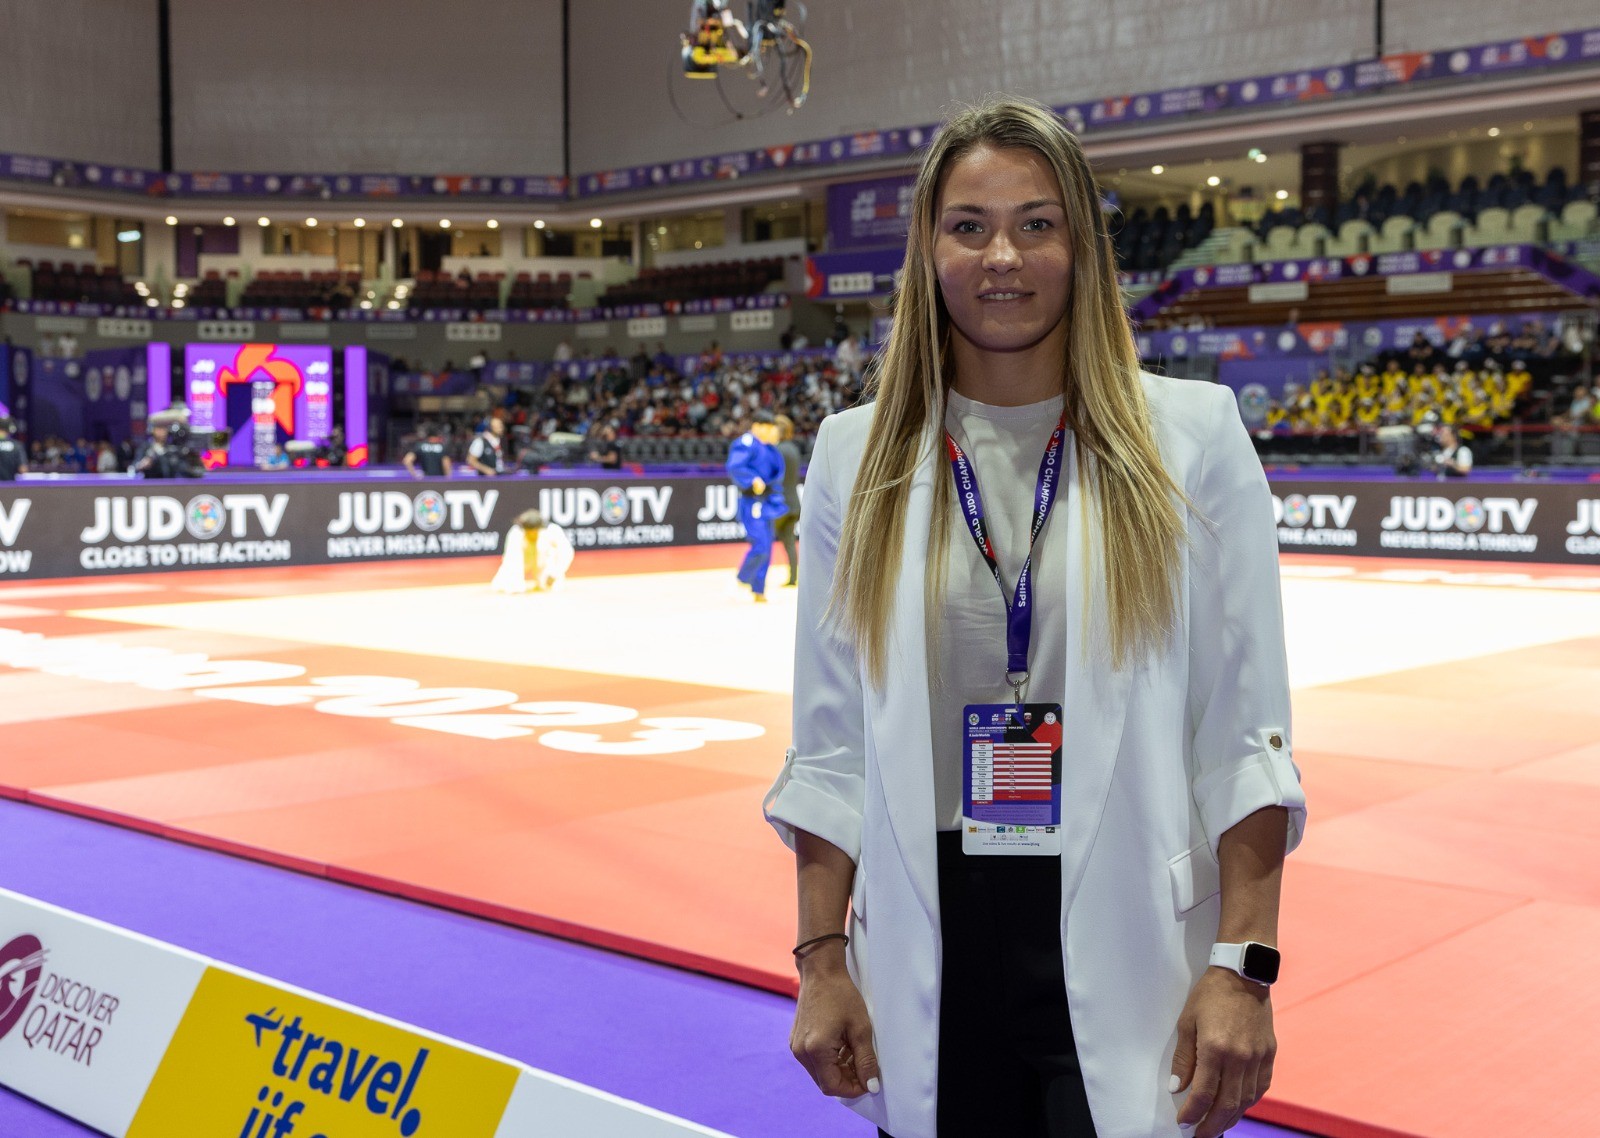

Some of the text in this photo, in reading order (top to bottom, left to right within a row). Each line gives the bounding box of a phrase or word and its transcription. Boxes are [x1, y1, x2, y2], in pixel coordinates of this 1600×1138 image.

[965, 492, 978, 516] JUDO
[327, 531, 500, 558] NEVER MISS A THROW
[575, 528, 597, 547] TO
[597, 526, 623, 545] THE
[623, 524, 674, 544] ACTION
[1380, 530, 1428, 549] NEVER
[1478, 533, 1538, 552] THROW
[80, 540, 291, 569] CLOSE TO THE ACTION
[40, 973, 120, 1025] DISCOVER
[23, 1004, 103, 1066] QATAR
